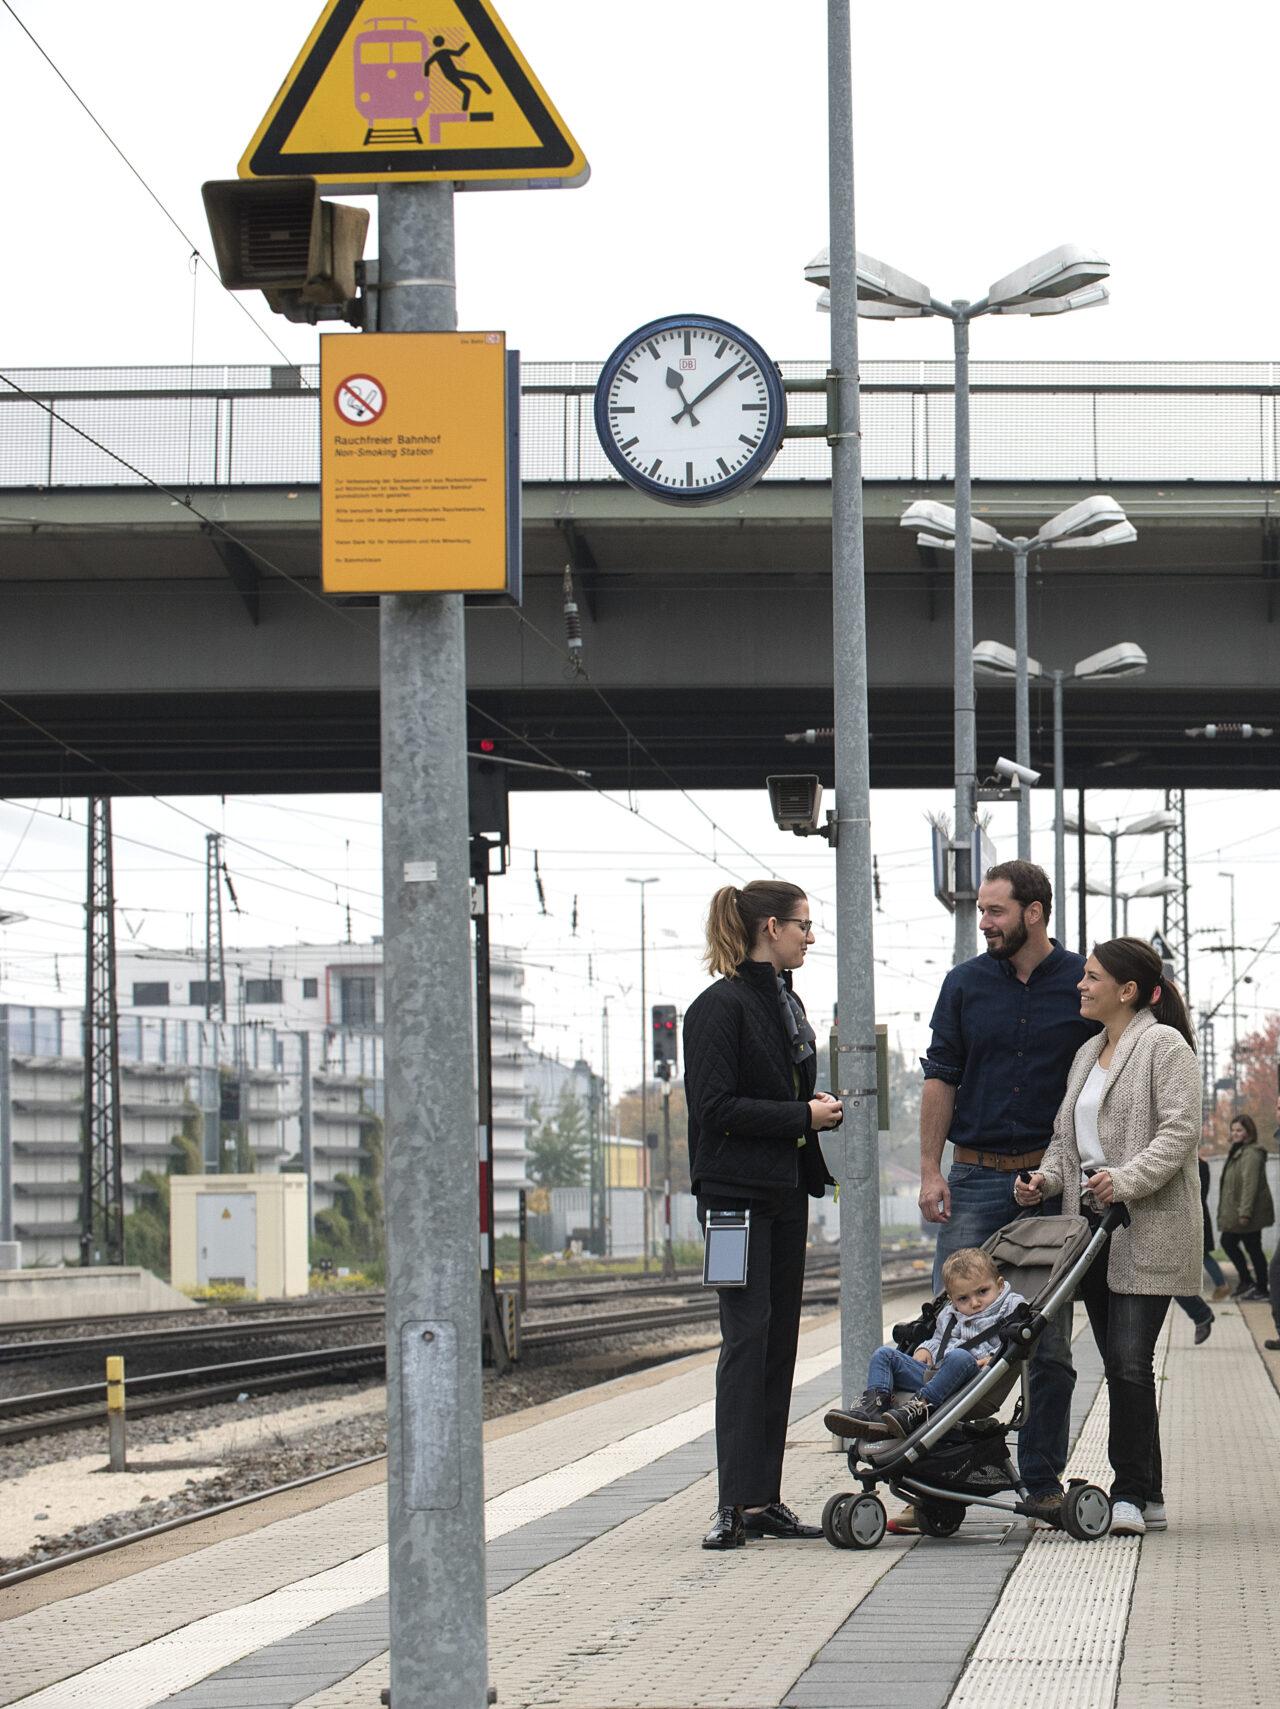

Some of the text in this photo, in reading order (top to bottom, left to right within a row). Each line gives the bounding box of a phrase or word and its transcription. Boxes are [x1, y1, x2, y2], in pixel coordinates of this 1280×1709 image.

[682, 360, 693, 369] DB
[335, 434, 441, 445] Rauchfreier Bahnhof
[335, 447, 434, 458] Non-Smoking Station
